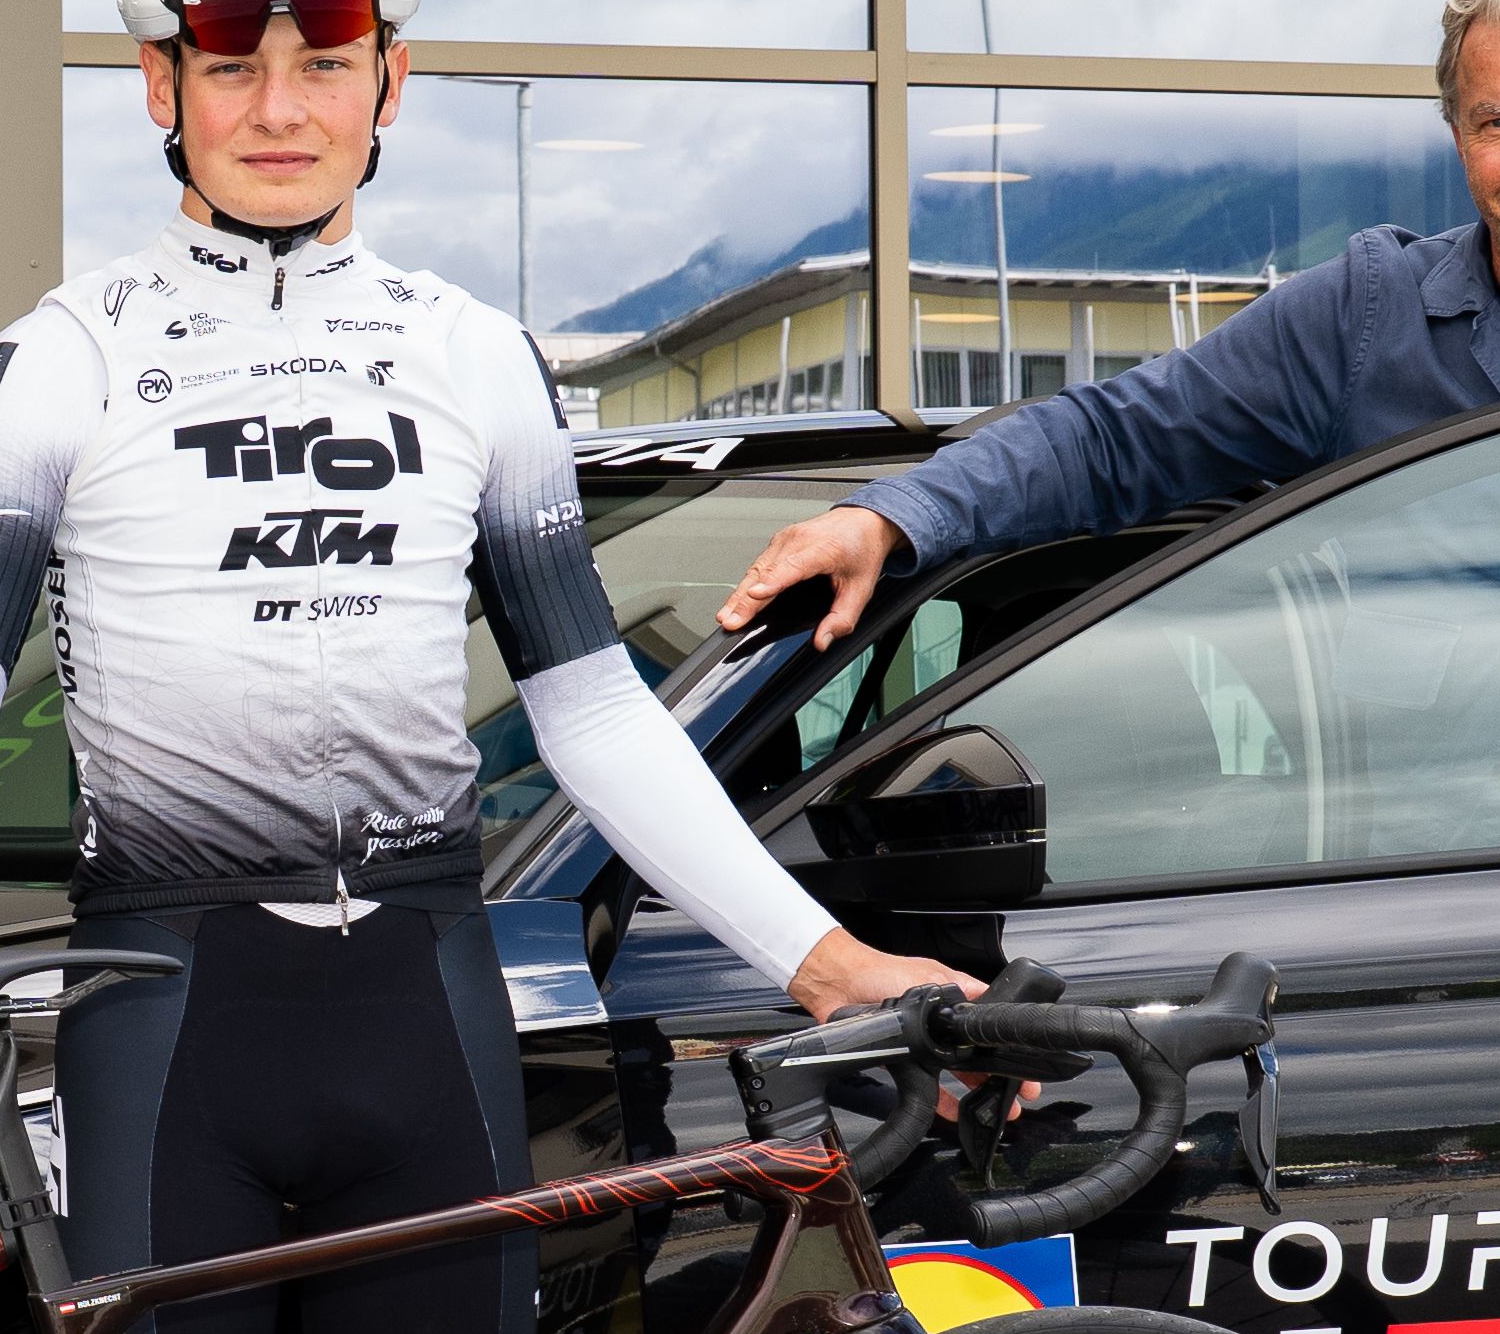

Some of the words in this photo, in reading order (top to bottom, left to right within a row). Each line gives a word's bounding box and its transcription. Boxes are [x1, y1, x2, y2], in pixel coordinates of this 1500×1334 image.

[189, 245, 248, 273] Tirol
[189, 313, 208, 321] UCI
[341, 321, 405, 334] CUORE
[194, 327, 217, 337] TEAM
[180, 368, 240, 383] PORSCHE
[174, 410, 423, 491] Tirol
[218, 508, 399, 572] KTM
[253, 601, 301, 622] DT
[307, 595, 382, 621] SWISS
[361, 810, 408, 833] Ride
[360, 829, 444, 866] passion
